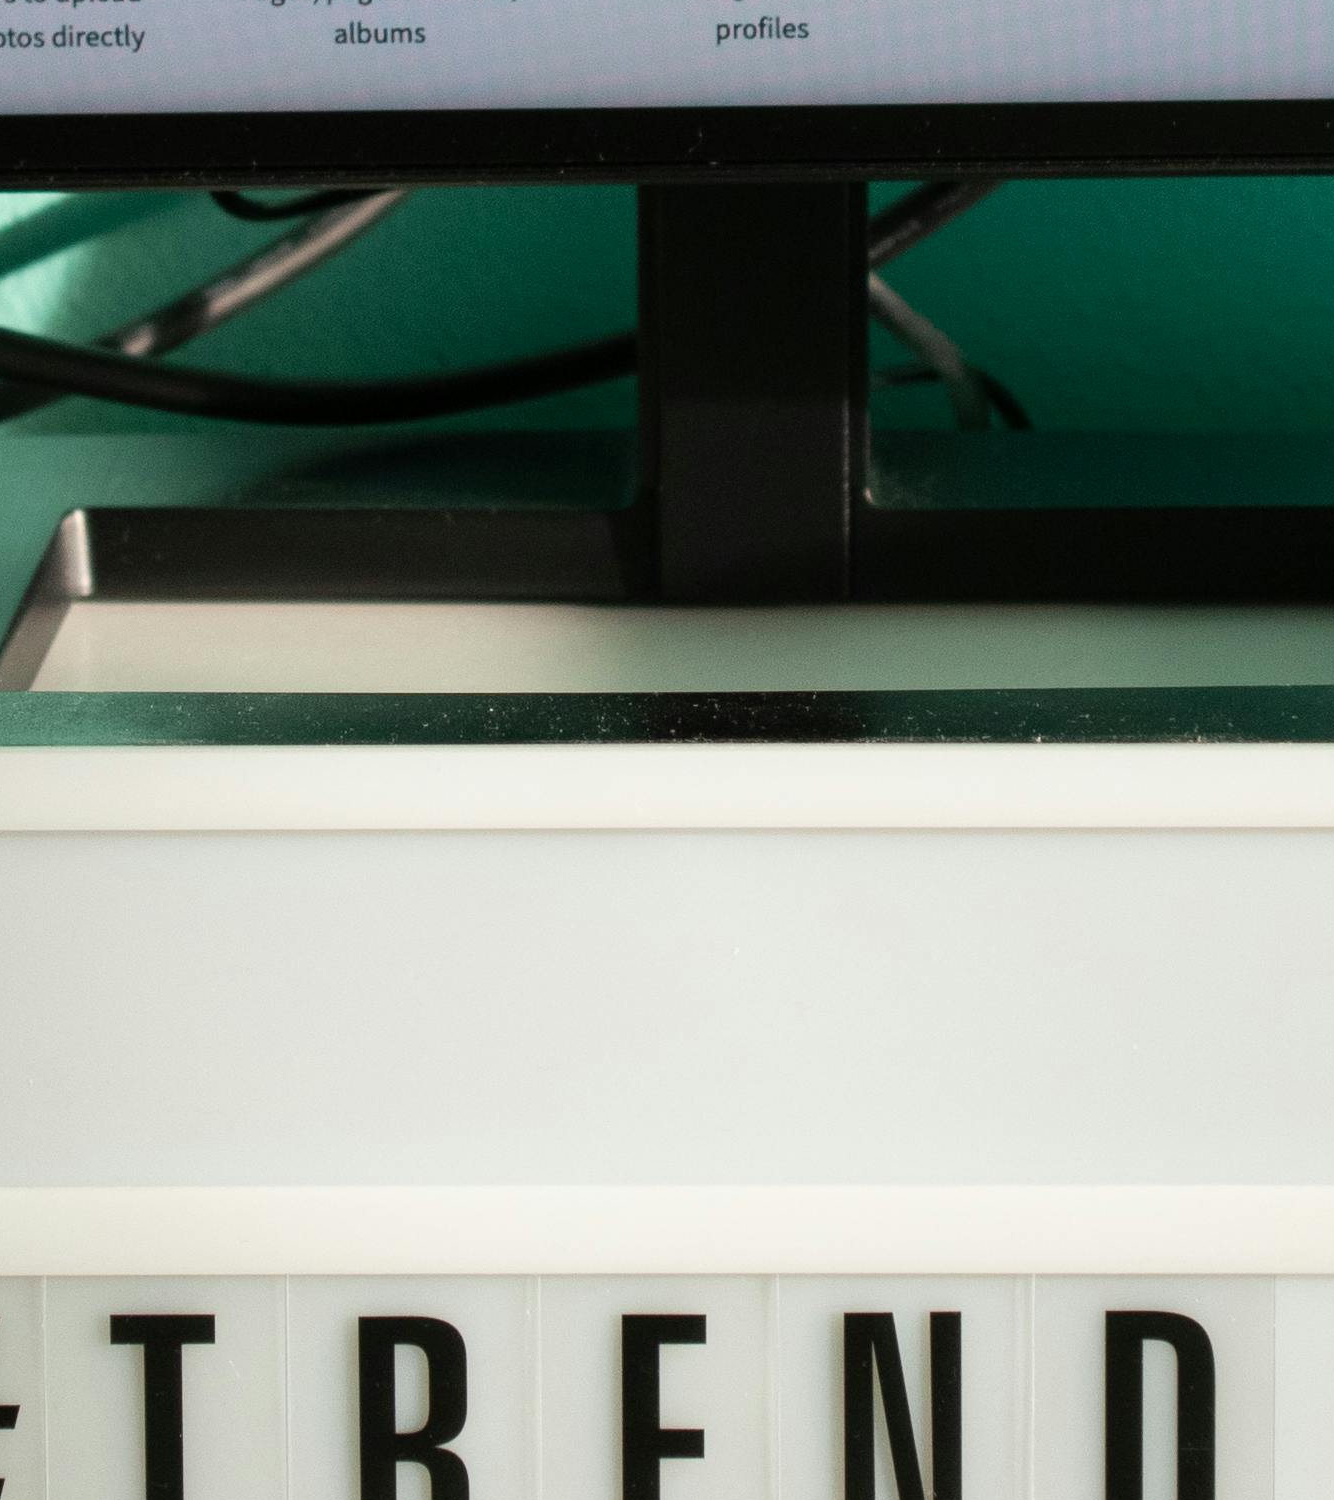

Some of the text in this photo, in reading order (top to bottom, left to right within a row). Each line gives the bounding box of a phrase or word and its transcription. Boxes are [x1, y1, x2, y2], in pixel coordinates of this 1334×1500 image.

[51, 23, 146, 53] directly
[333, 20, 427, 45] albums
[715, 14, 810, 46] profiles
